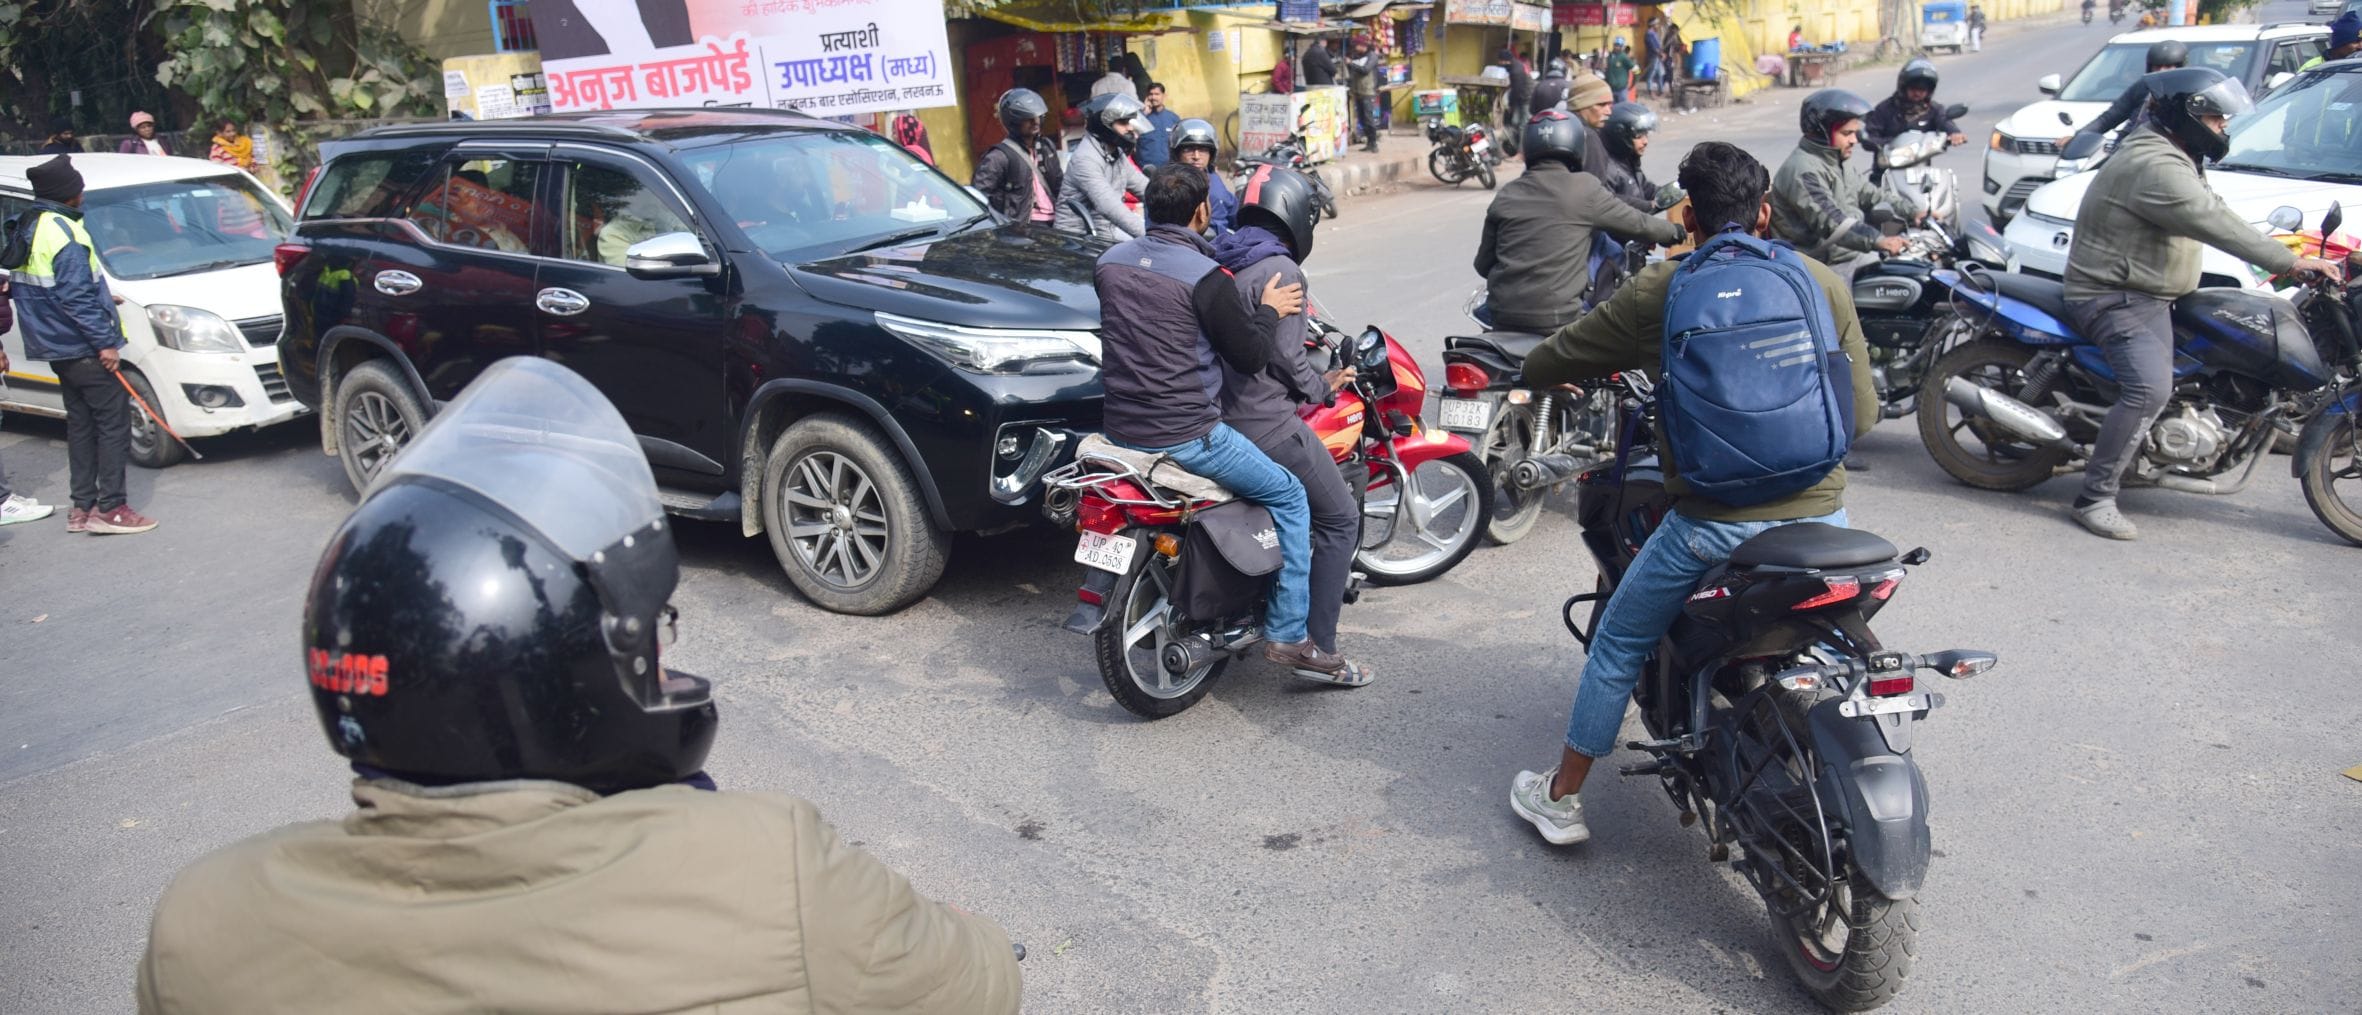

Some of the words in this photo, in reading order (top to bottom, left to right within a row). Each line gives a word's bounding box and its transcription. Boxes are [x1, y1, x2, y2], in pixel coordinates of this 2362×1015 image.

[819, 22, 879, 52] प्रत्याशी
[548, 65, 637, 110] अनुज
[639, 39, 752, 98] बाजपेई
[774, 53, 873, 89] उपाध्यक्ष
[881, 50, 936, 84] (मध्य)
[818, 95, 836, 109] बार
[902, 84, 944, 100] लखनऊ
